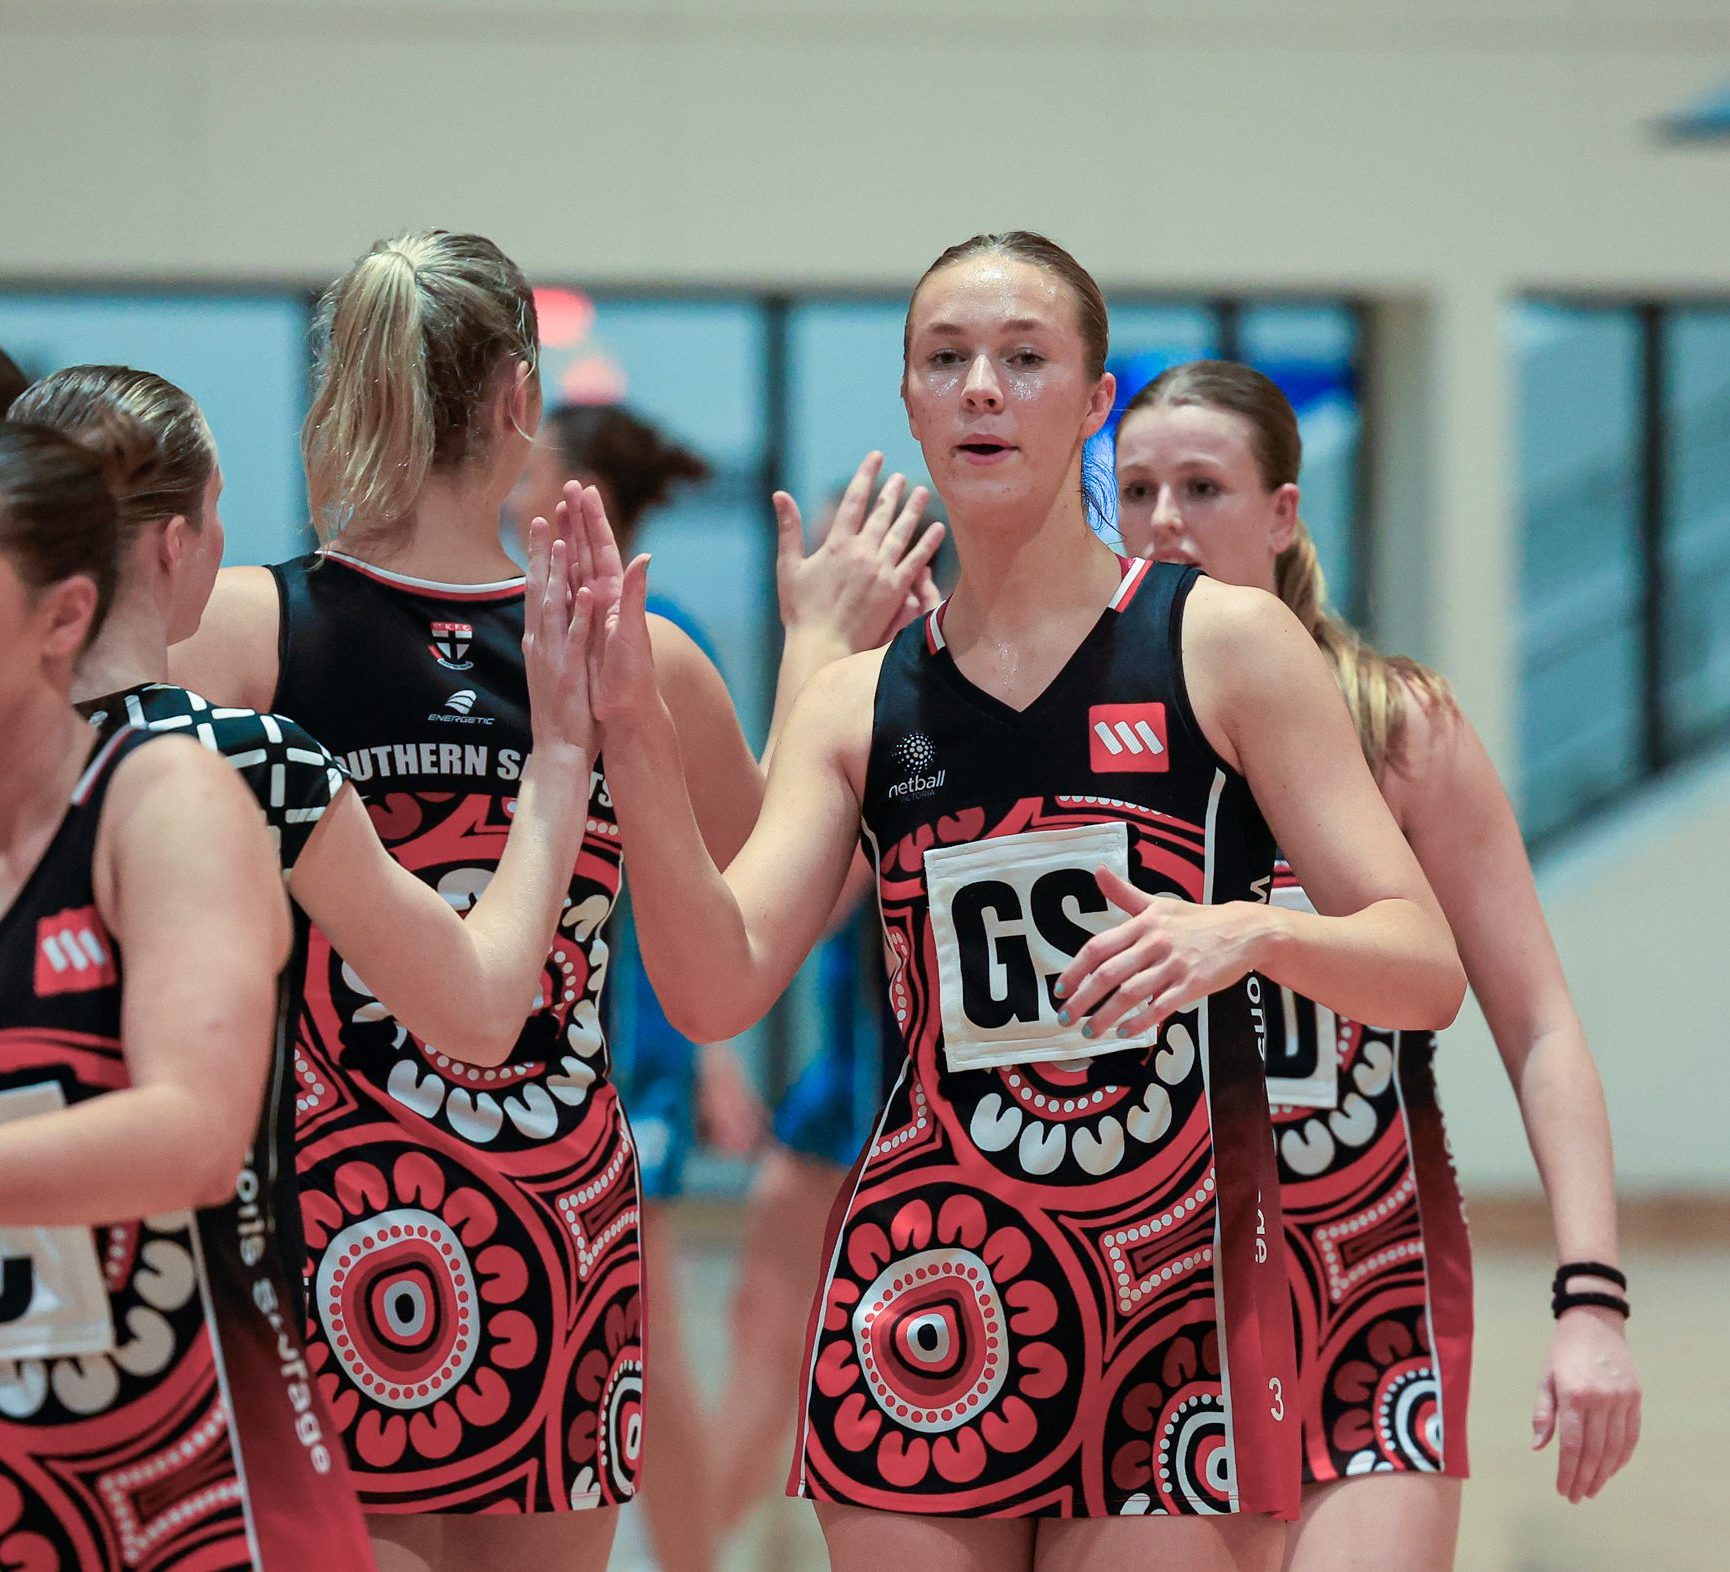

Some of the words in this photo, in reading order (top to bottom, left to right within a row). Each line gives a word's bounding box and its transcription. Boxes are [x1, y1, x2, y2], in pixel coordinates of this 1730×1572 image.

[428, 713, 495, 725] ENERGETIC
[333, 743, 488, 781] UTHERN
[888, 769, 946, 798] netball
[951, 868, 1121, 1029] GS
[1268, 1377, 1285, 1421] 3
